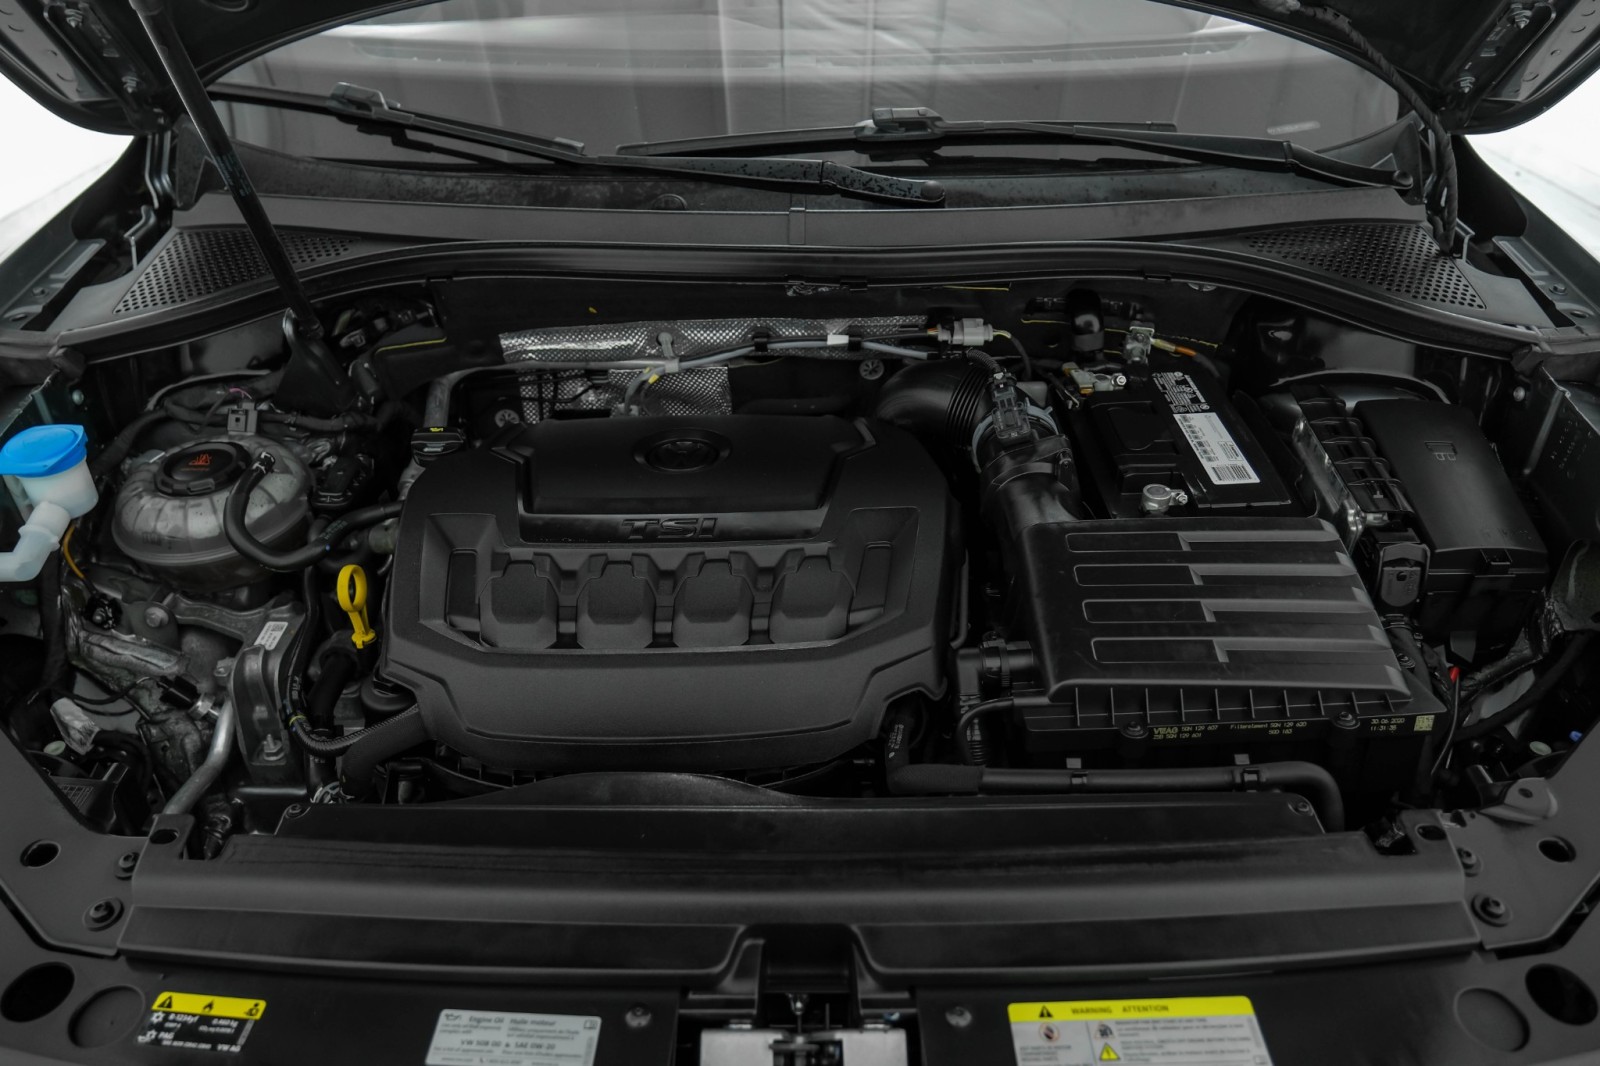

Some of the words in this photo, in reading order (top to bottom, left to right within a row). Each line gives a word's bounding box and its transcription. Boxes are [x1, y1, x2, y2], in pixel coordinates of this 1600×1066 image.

[621, 517, 718, 540] TSI
[1071, 1006, 1112, 1015] WARNING
[1122, 1004, 1169, 1013] ATTENTION
[469, 1015, 492, 1024] Engine
